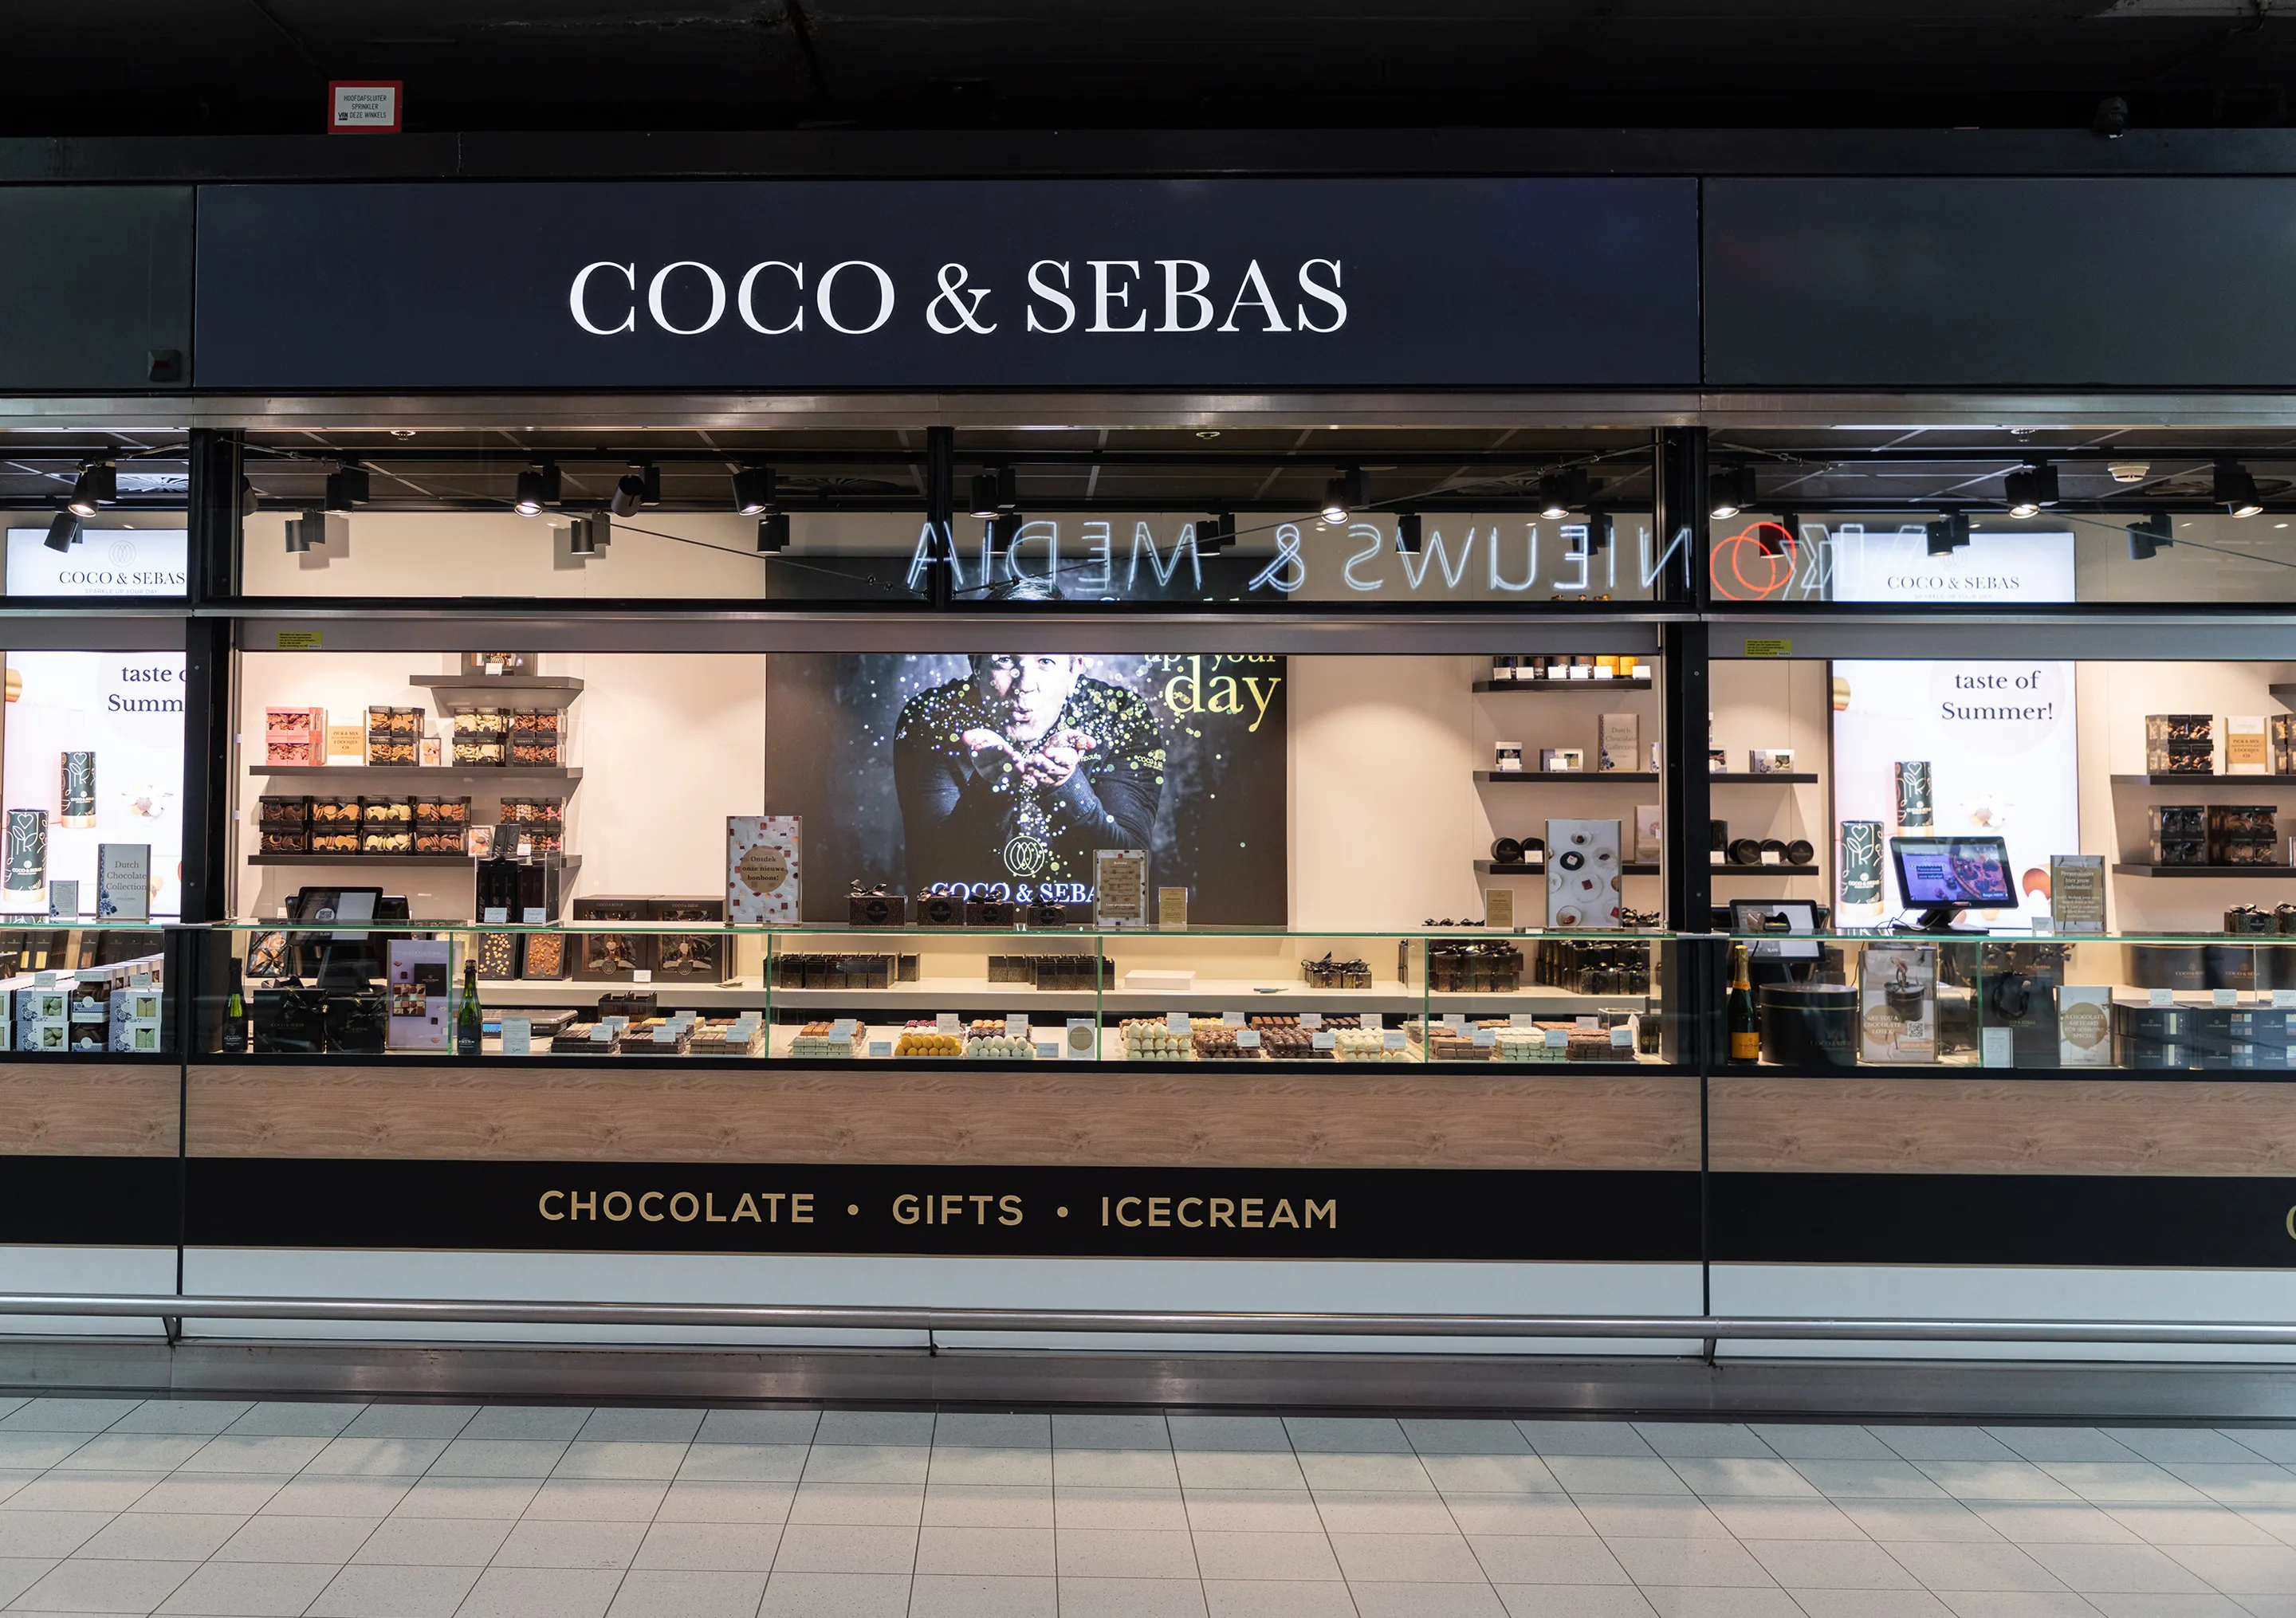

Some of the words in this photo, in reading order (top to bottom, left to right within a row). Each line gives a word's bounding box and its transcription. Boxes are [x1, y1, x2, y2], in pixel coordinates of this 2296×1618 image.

[569, 261, 895, 335] COCO
[926, 263, 997, 335] &
[1028, 259, 1347, 334] SEBAS
[59, 571, 112, 584] COCO
[117, 572, 128, 585] &
[133, 572, 185, 585] SEBAS
[1887, 576, 1943, 589] COCO
[1948, 577, 1959, 589] &
[1965, 576, 2019, 589] SEBAS
[121, 667, 172, 682] taste
[1955, 674, 2007, 689] taste
[2015, 670, 2041, 689] of
[1165, 655, 1282, 732] day
[108, 694, 184, 712] Summ
[1942, 702, 2053, 720] Summer!
[931, 882, 1011, 902] COCO
[1016, 884, 1033, 902] &
[539, 1190, 814, 1223] CHOCOLATE
[892, 1194, 1023, 1226] GIFTS
[1102, 1196, 1336, 1229] ICECREAM
